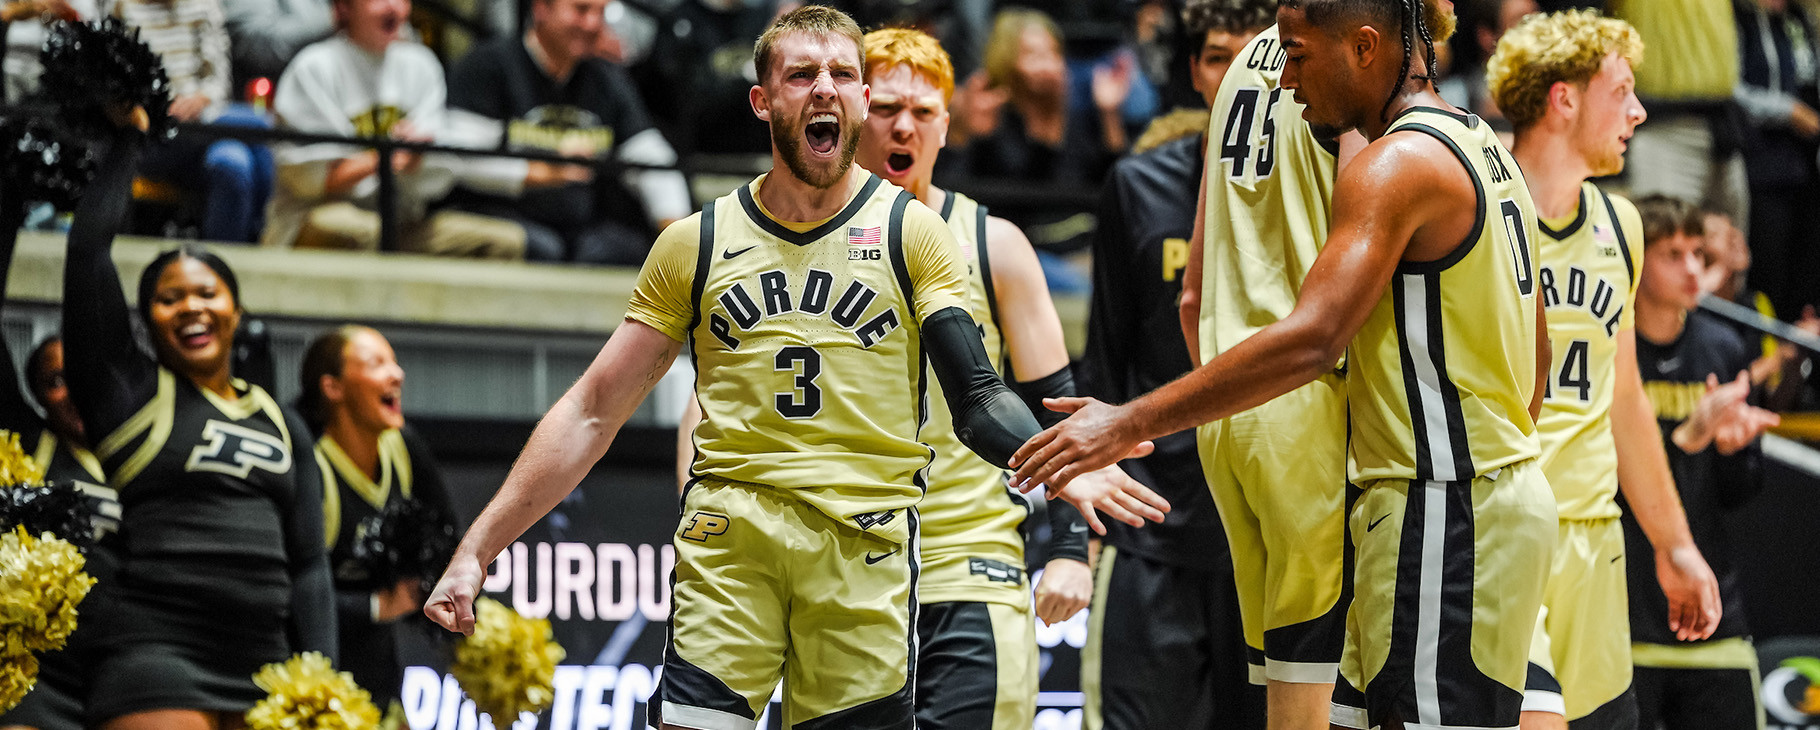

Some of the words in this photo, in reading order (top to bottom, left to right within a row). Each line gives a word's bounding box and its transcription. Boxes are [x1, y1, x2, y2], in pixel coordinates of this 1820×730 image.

[1220, 86, 1283, 179] 45
[1500, 198, 1533, 298] 0
[709, 268, 901, 352] PURDUE
[774, 345, 822, 420] 3
[184, 418, 292, 480] P
[681, 511, 730, 543] P
